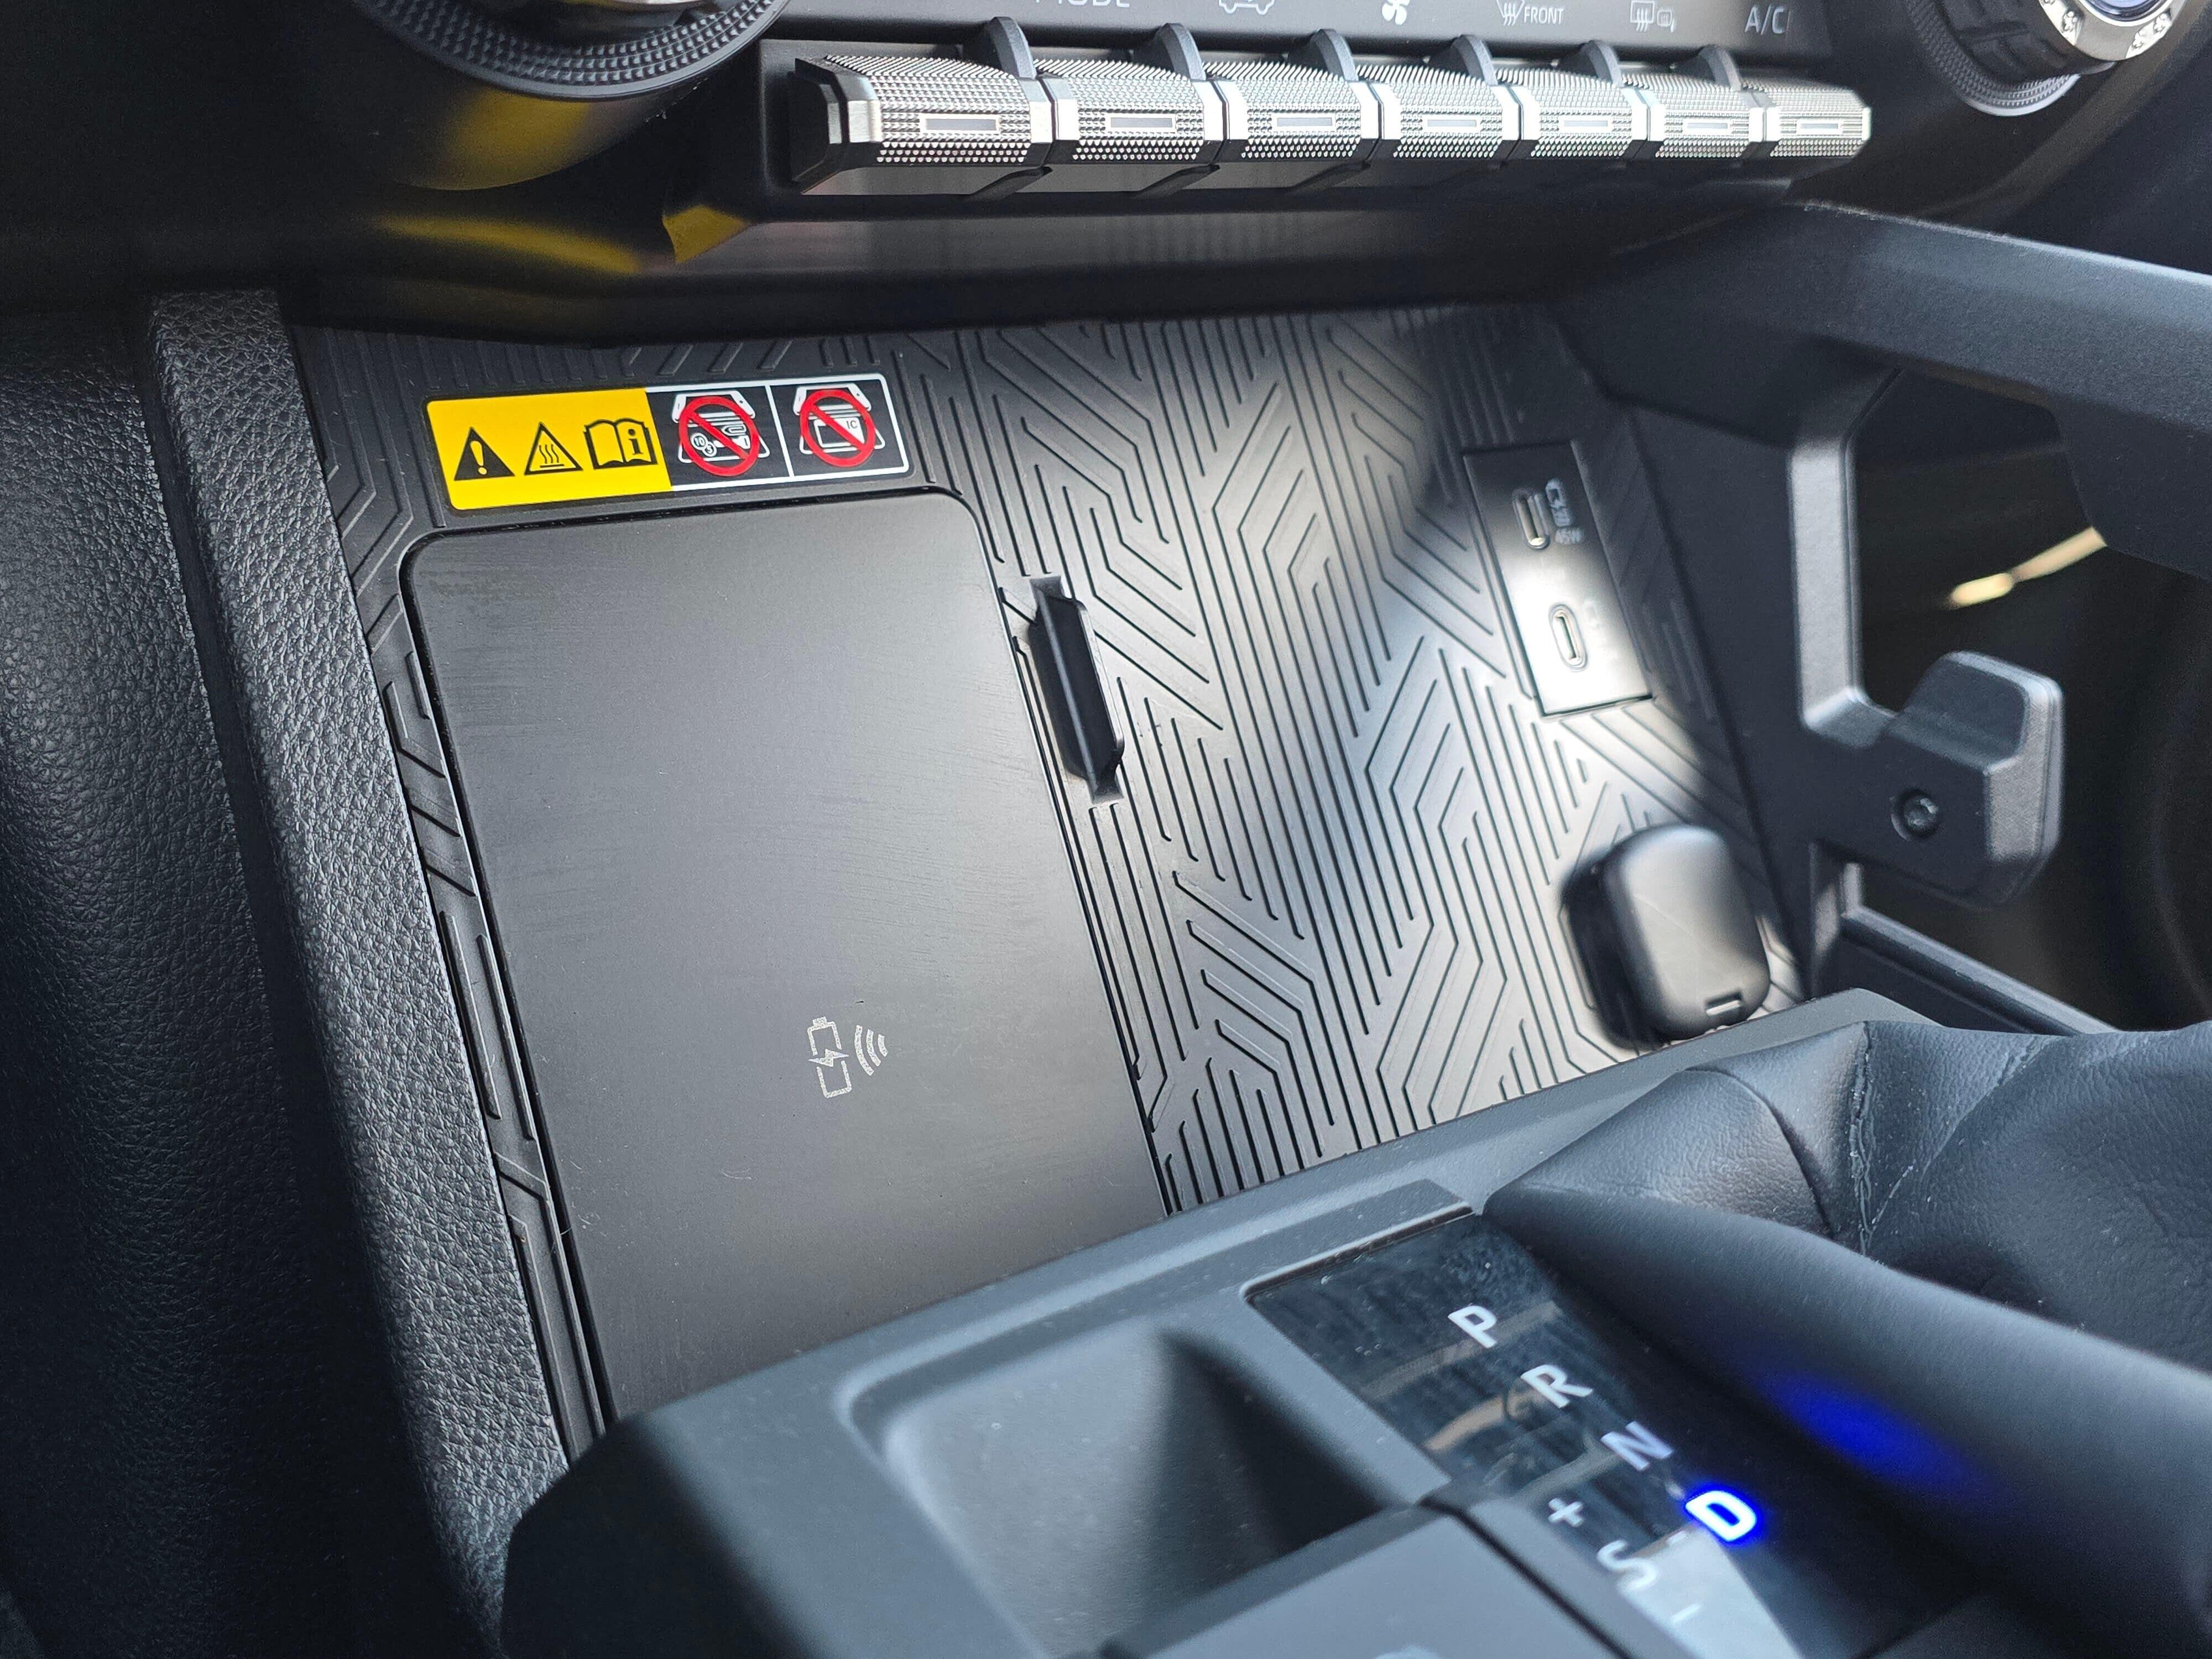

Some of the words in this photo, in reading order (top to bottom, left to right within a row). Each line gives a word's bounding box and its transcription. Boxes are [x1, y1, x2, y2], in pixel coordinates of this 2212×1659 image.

[1524, 6, 1564, 25] FRONT
[1744, 4, 1785, 35] A/C
[846, 420, 858, 429] IC
[1448, 1305, 1497, 1348] P
[1520, 1364, 1593, 1408] R
[1601, 1421, 1674, 1471] N
[1685, 1490, 1757, 1542] D
[1597, 1539, 1657, 1592] S
